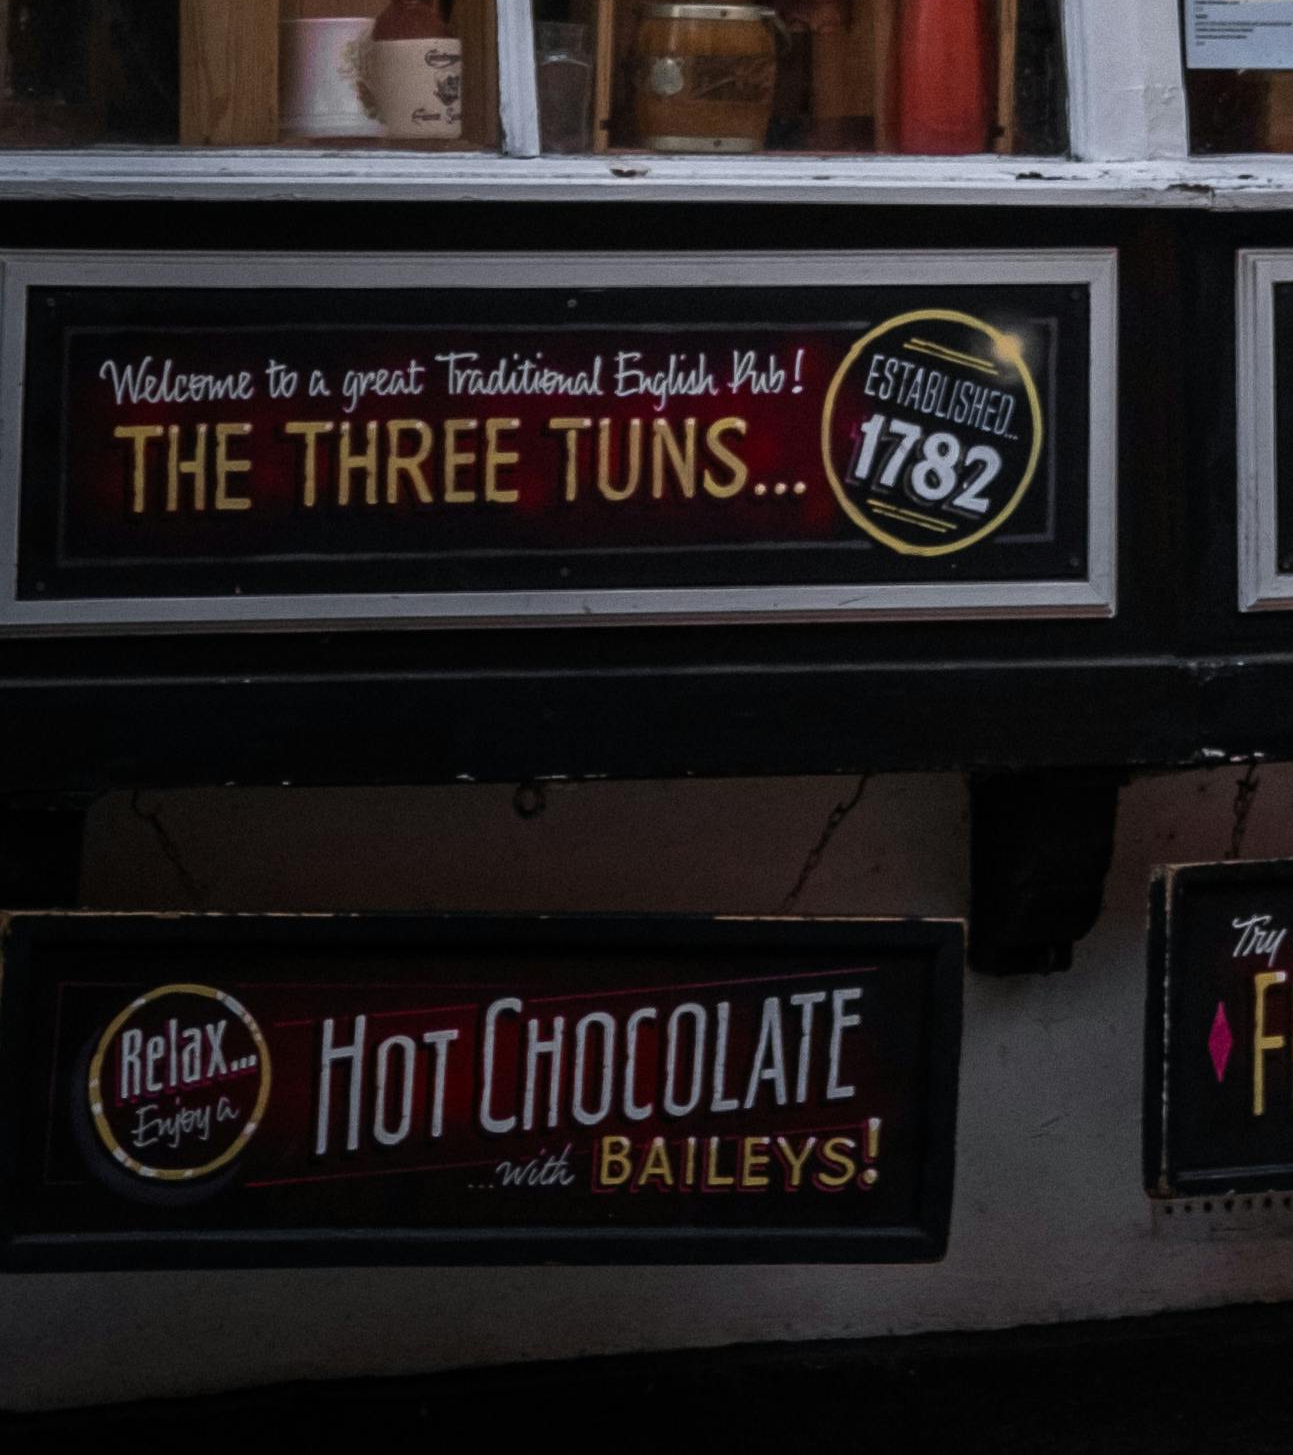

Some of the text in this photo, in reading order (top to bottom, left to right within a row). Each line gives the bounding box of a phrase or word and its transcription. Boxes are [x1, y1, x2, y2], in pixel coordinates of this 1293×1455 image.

[98, 348, 805, 414] Welcome to a great Traditional English Pub!
[113, 415, 808, 514] THE THREE TUNS...
[854, 413, 1002, 515] 1782
[1231, 913, 1288, 968] Try
[119, 1017, 259, 1100] Relax...
[314, 985, 865, 1157] HOT CHOCOLATE
[130, 1095, 241, 1150] Enjoy a
[597, 1116, 885, 1191] BAILEYS!
